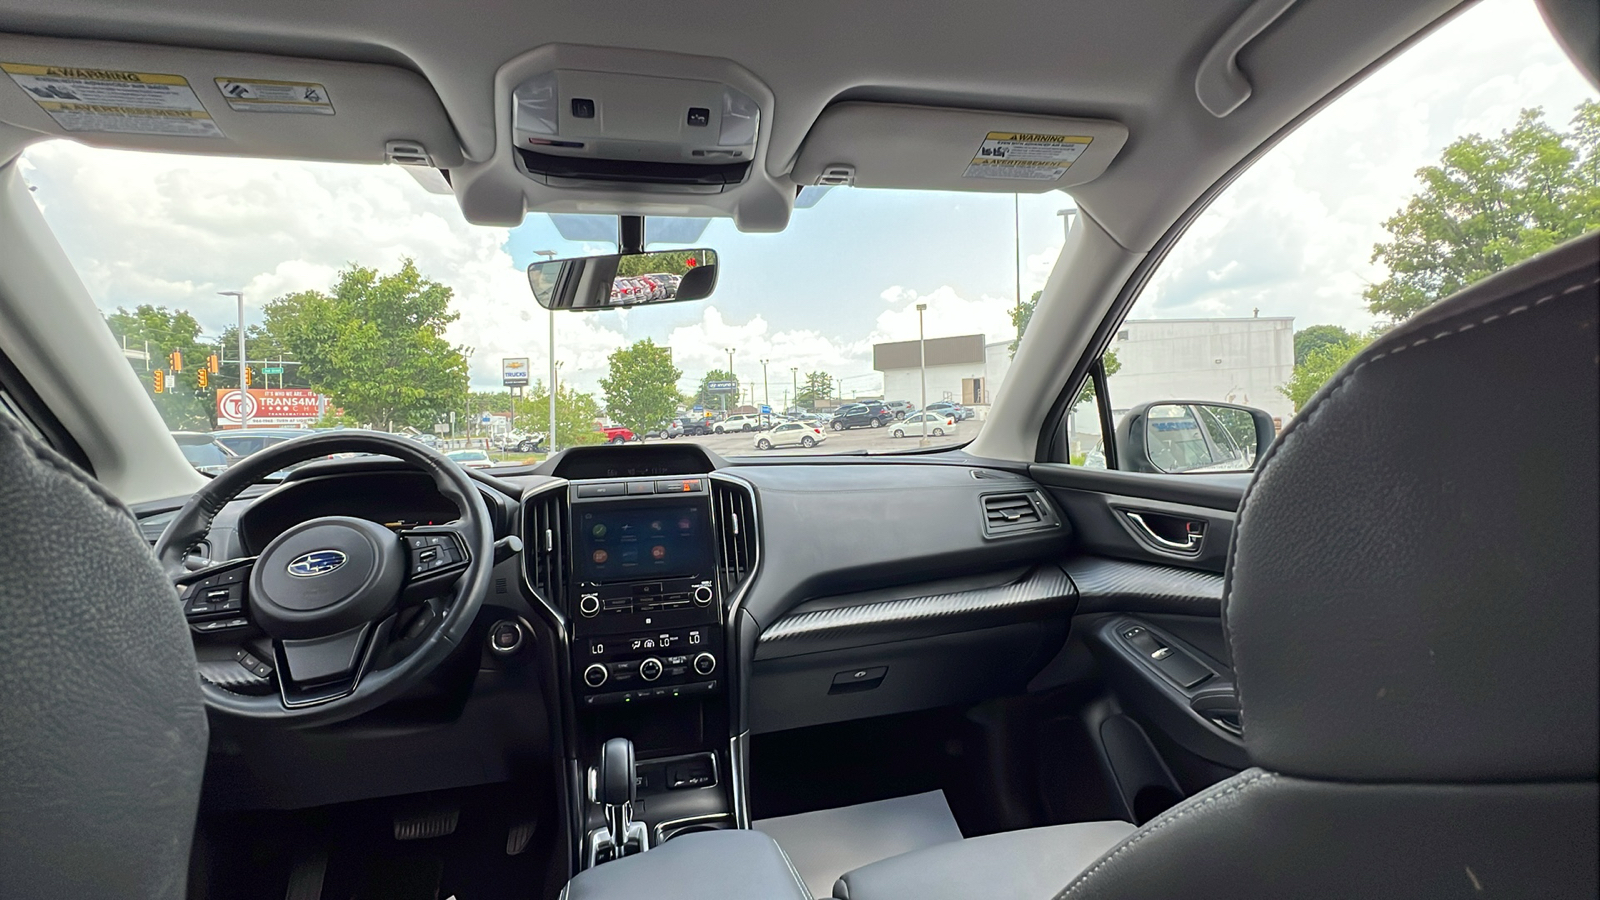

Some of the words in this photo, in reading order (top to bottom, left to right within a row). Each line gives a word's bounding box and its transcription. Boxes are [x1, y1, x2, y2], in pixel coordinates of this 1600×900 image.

[59, 67, 141, 82] WARNING
[1018, 134, 1065, 143] WARNING
[992, 159, 1062, 167] AVERTISSEMENT
[592, 644, 604, 654] LO
